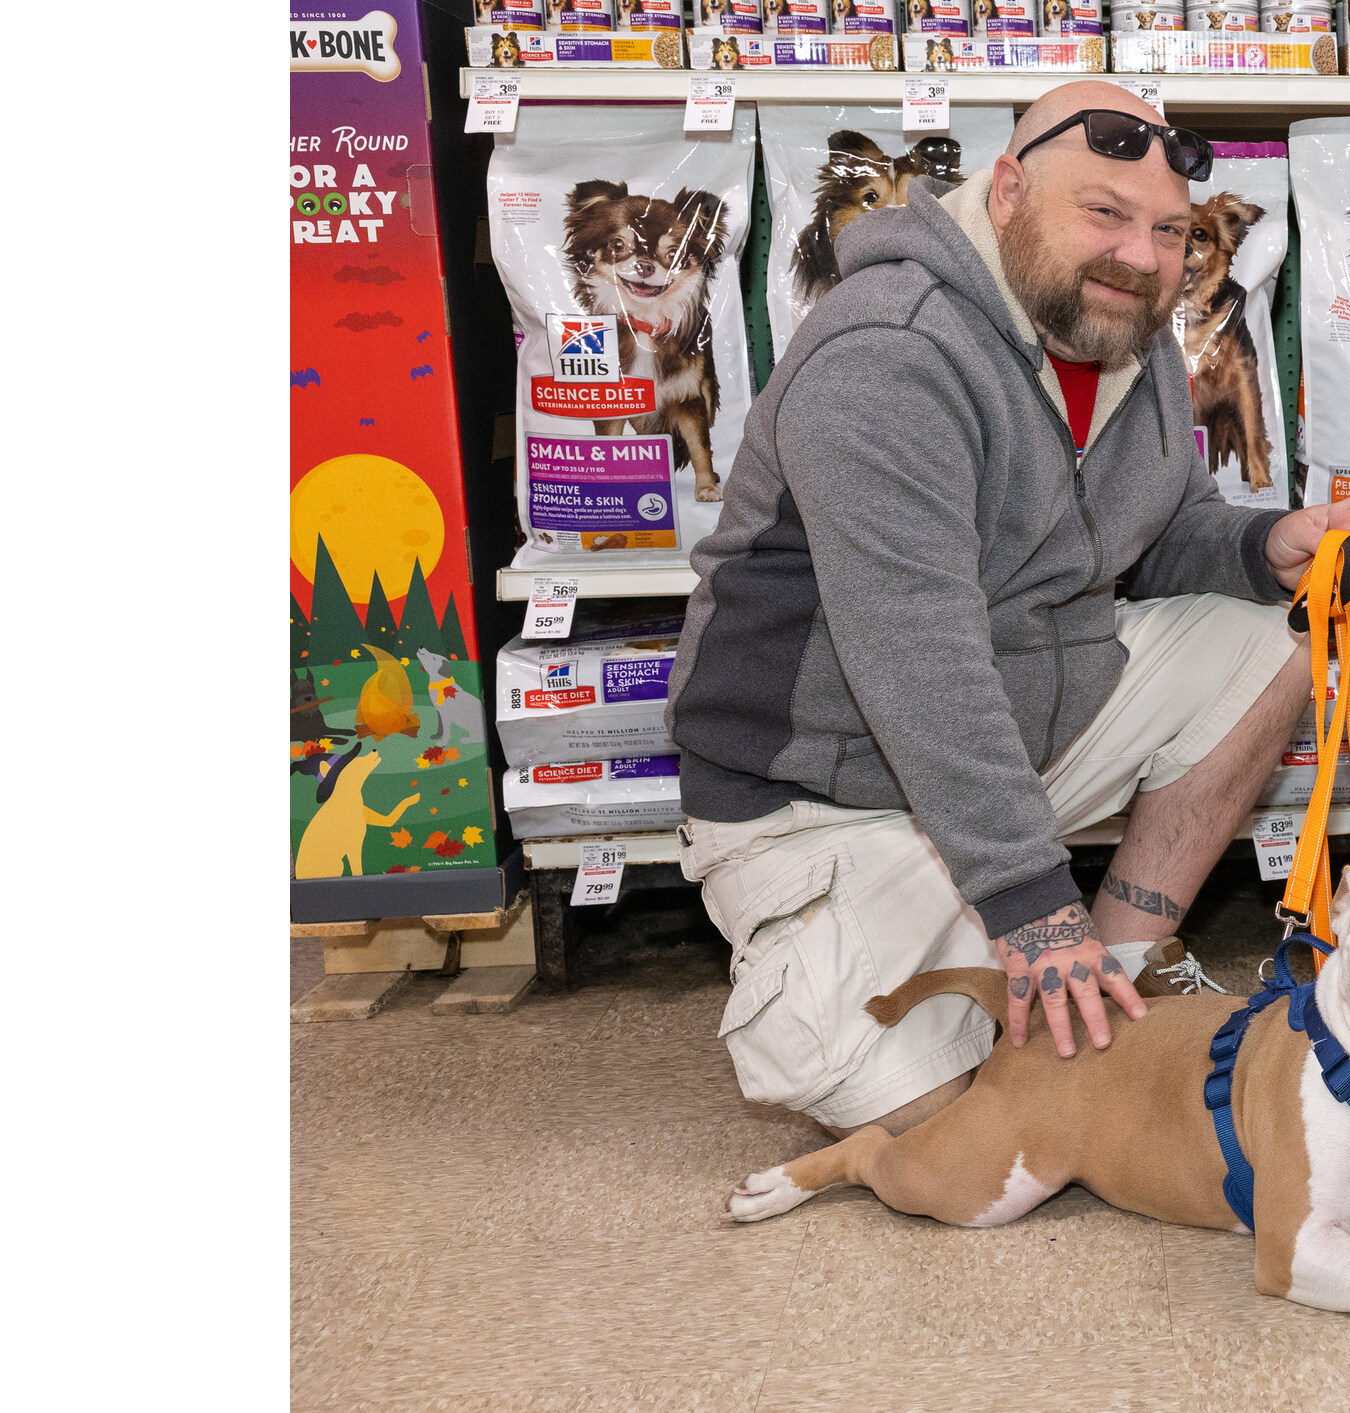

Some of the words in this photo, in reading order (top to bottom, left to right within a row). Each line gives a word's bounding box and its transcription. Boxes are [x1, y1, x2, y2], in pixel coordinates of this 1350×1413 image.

[352, 164, 376, 188] A
[560, 358, 609, 376] Hill's
[536, 386, 600, 401] SCIENCE
[606, 388, 645, 401] DIET
[530, 442, 585, 460] SMALL
[590, 446, 606, 461] &
[612, 445, 661, 460] MINI
[531, 462, 551, 471] ADULT
[533, 482, 580, 495] SENSITIVE
[533, 494, 581, 505] STOMACH
[584, 497, 593, 506] &
[596, 497, 624, 506] SKIN
[607, 661, 660, 672] SENSITIVE
[606, 669, 659, 679] STOMACH
[547, 678, 572, 688] Hill's
[618, 678, 643, 686] SKIN
[530, 692, 568, 702] SCIENCE
[538, 768, 574, 777] SCIENCE
